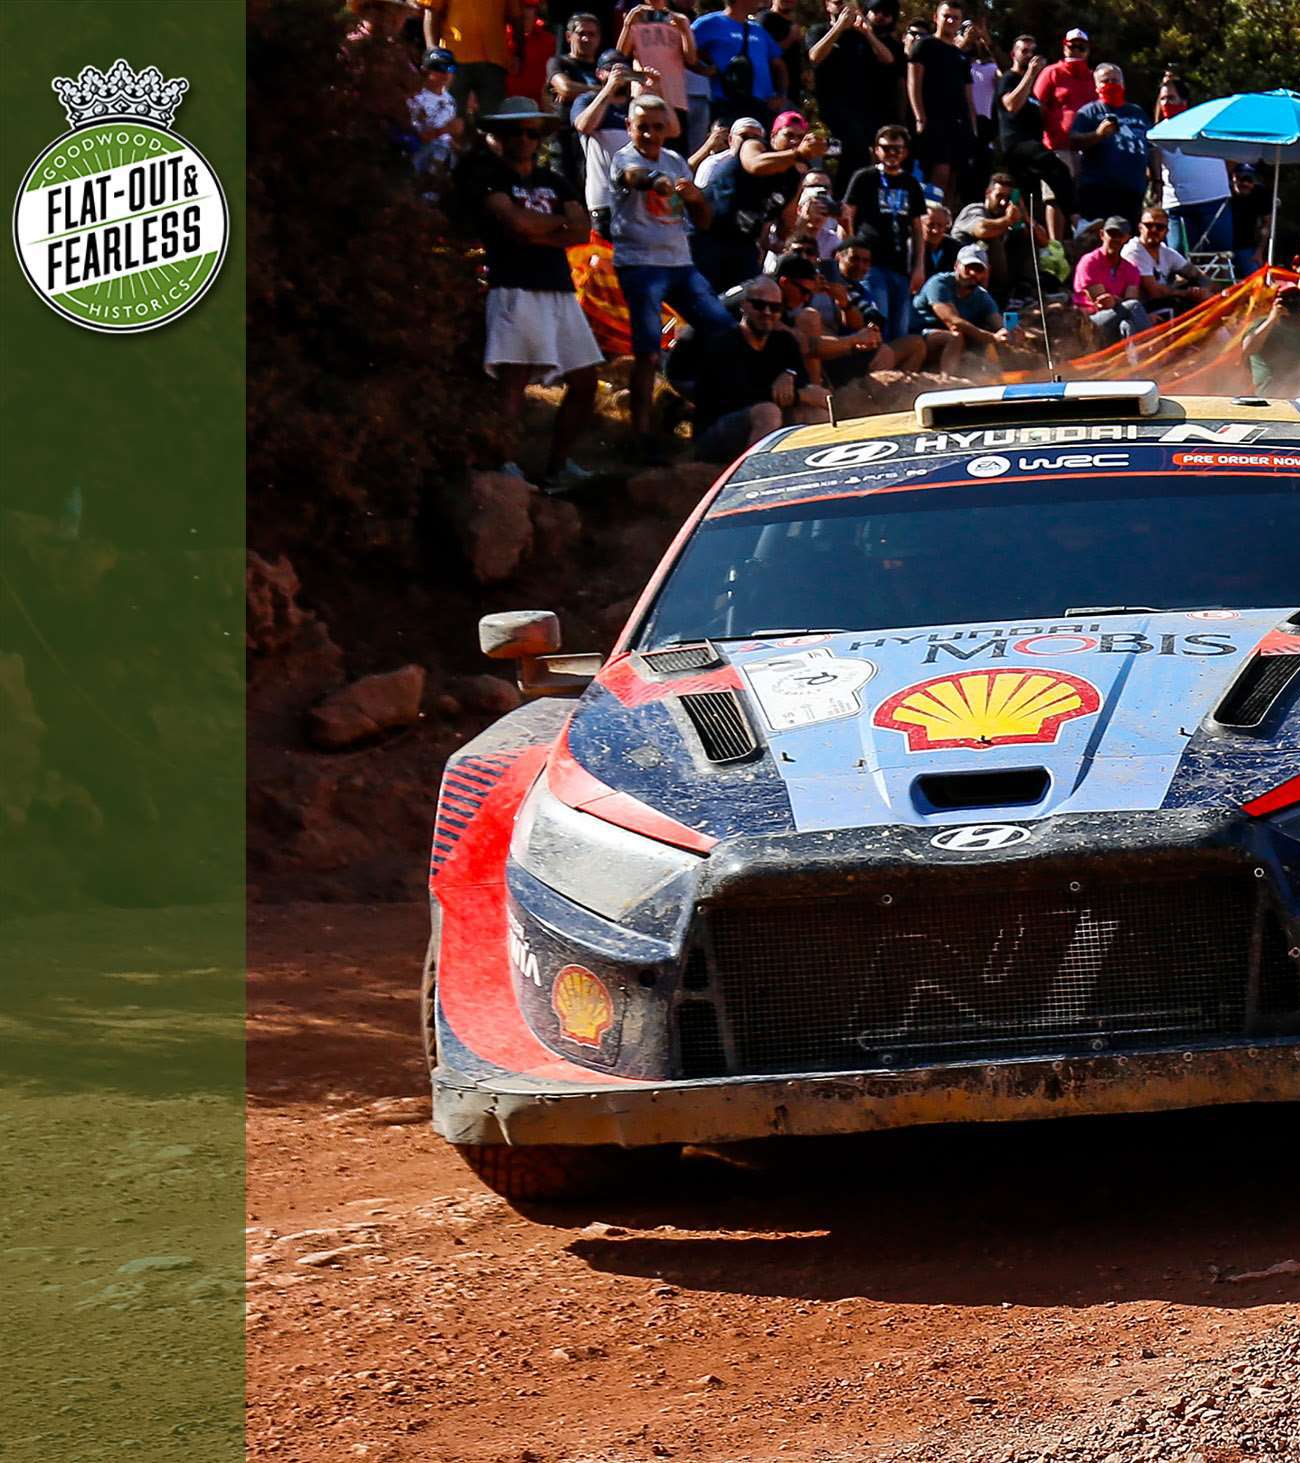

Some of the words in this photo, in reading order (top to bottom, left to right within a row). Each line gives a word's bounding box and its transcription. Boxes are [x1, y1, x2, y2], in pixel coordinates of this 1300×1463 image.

[914, 425, 1137, 453] HYUNDAI
[1018, 454, 1129, 471] WRC
[1183, 455, 1213, 464] PRE
[1218, 456, 1270, 465] ORDER
[848, 624, 1100, 651] HYUNDAI
[921, 632, 1237, 664] MOBIS
